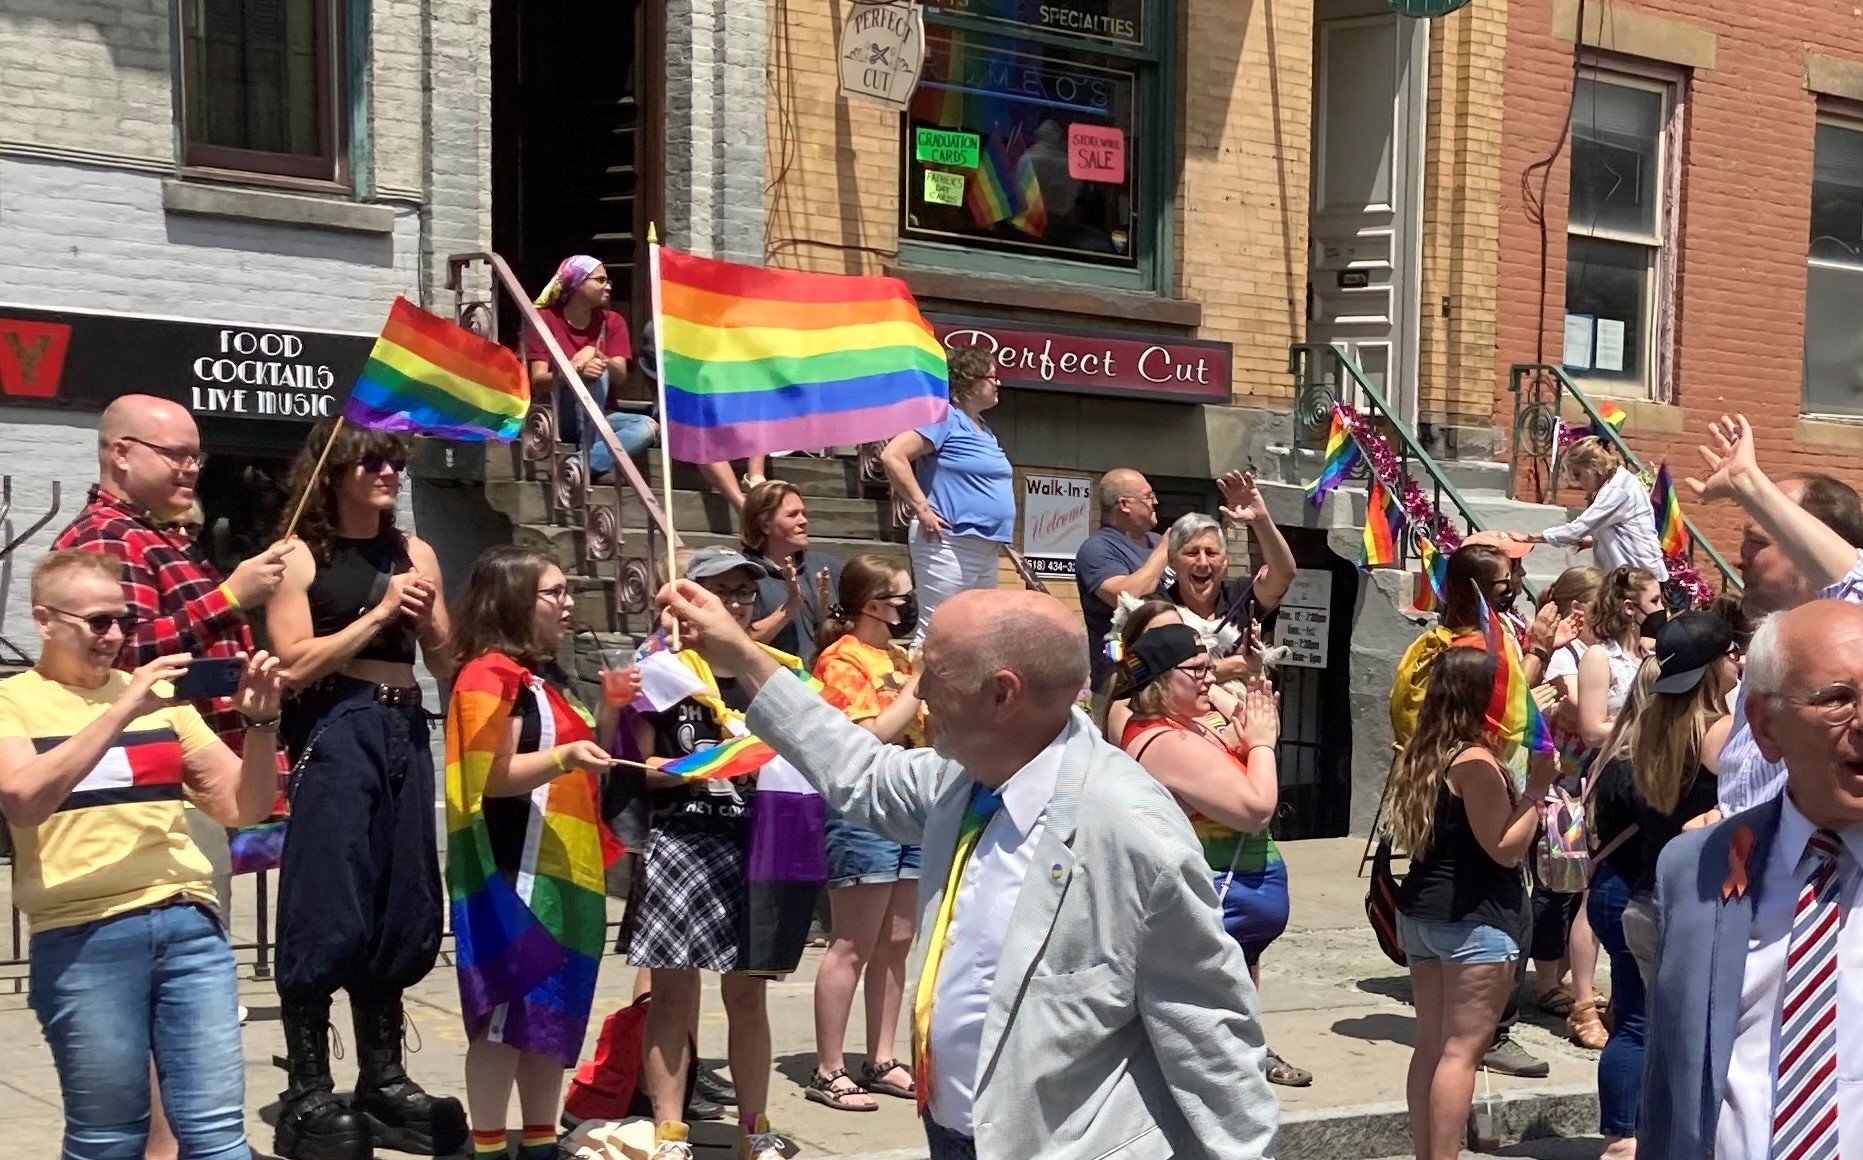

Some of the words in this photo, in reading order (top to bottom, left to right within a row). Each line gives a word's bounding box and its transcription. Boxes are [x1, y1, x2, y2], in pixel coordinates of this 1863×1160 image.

[855, 8, 913, 44] PERFECT
[1039, 5, 1134, 38] SPECIALTIES
[863, 67, 891, 92] CUT
[918, 131, 978, 154] GRADUATION
[929, 146, 968, 167] CARDS
[1077, 149, 1115, 170] SALE
[1, 331, 56, 385] Y
[220, 330, 303, 357] FOOD
[193, 357, 335, 390] COCKTAILS
[1138, 345, 1209, 385] Cut
[192, 387, 248, 413] LIVE
[256, 390, 336, 417] MUSIC
